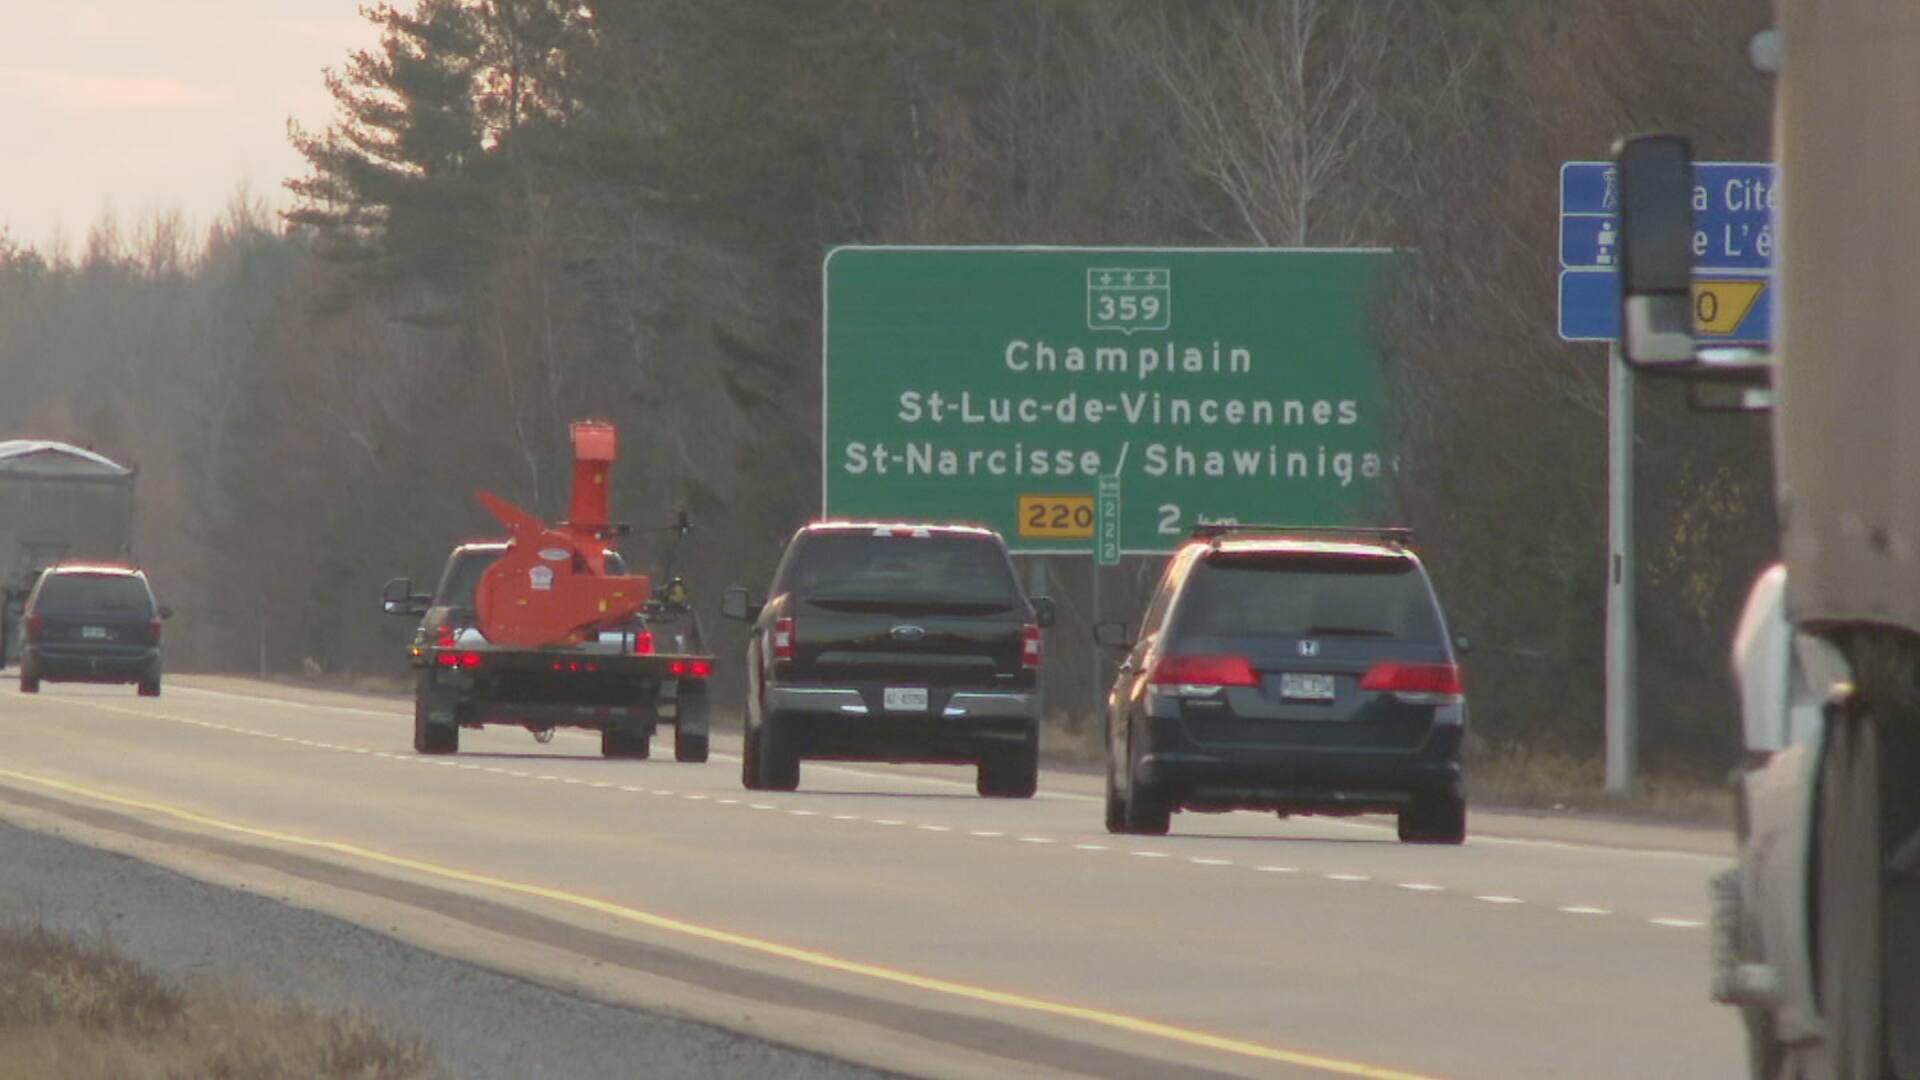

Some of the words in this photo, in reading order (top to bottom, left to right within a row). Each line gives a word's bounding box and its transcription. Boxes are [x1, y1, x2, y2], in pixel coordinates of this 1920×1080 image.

[1692, 185, 1708, 211] a
[1692, 230, 1708, 256] e
[1725, 223, 1772, 256] L'é
[1097, 296, 1160, 320] 359
[1005, 341, 1251, 379] Champlain
[898, 391, 1358, 422] St-Luc-de-Vincennes
[845, 442, 1101, 475] St-Narcisse
[1028, 504, 1093, 529] 220
[1158, 504, 1181, 534] 2
